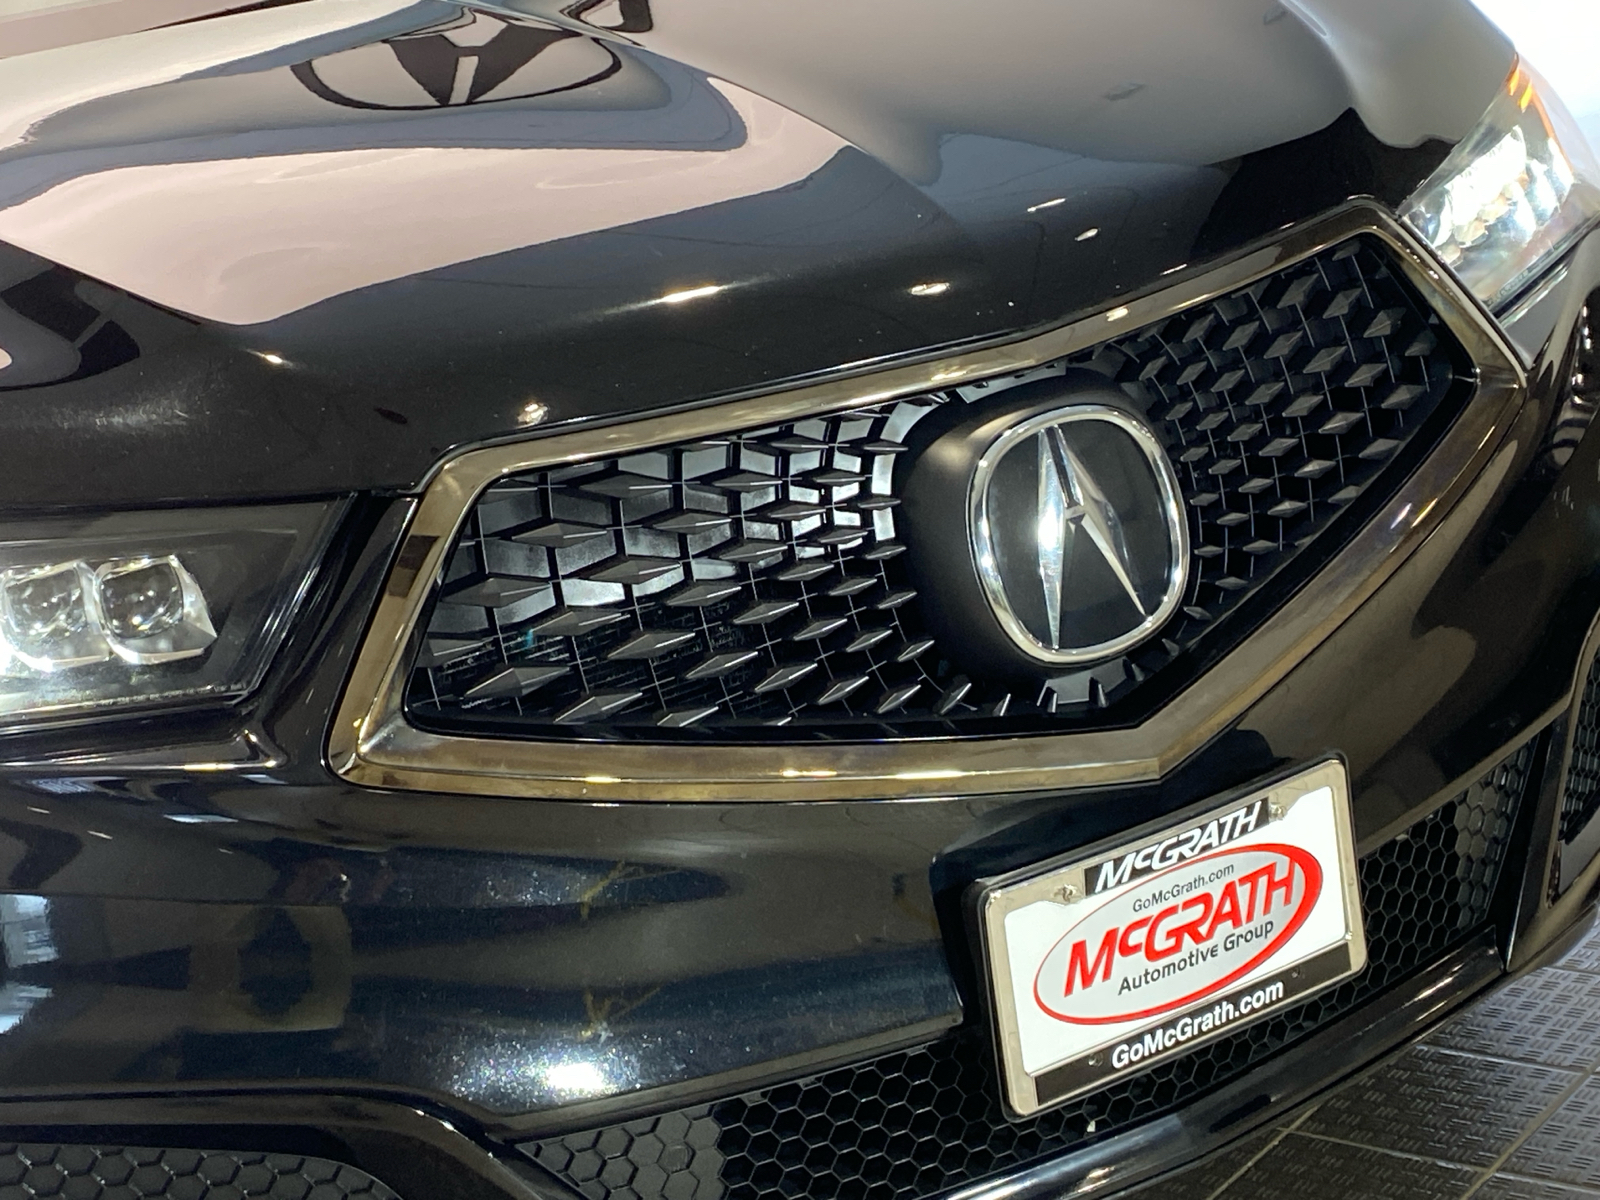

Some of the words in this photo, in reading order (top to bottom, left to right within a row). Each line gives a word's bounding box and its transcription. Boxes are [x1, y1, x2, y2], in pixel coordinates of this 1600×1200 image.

[1132, 863, 1235, 913] GoMcGrath.com
[1118, 944, 1218, 996] Automotive
[1223, 920, 1275, 952] Group
[1111, 980, 1284, 1070] GoMcGrath.com
